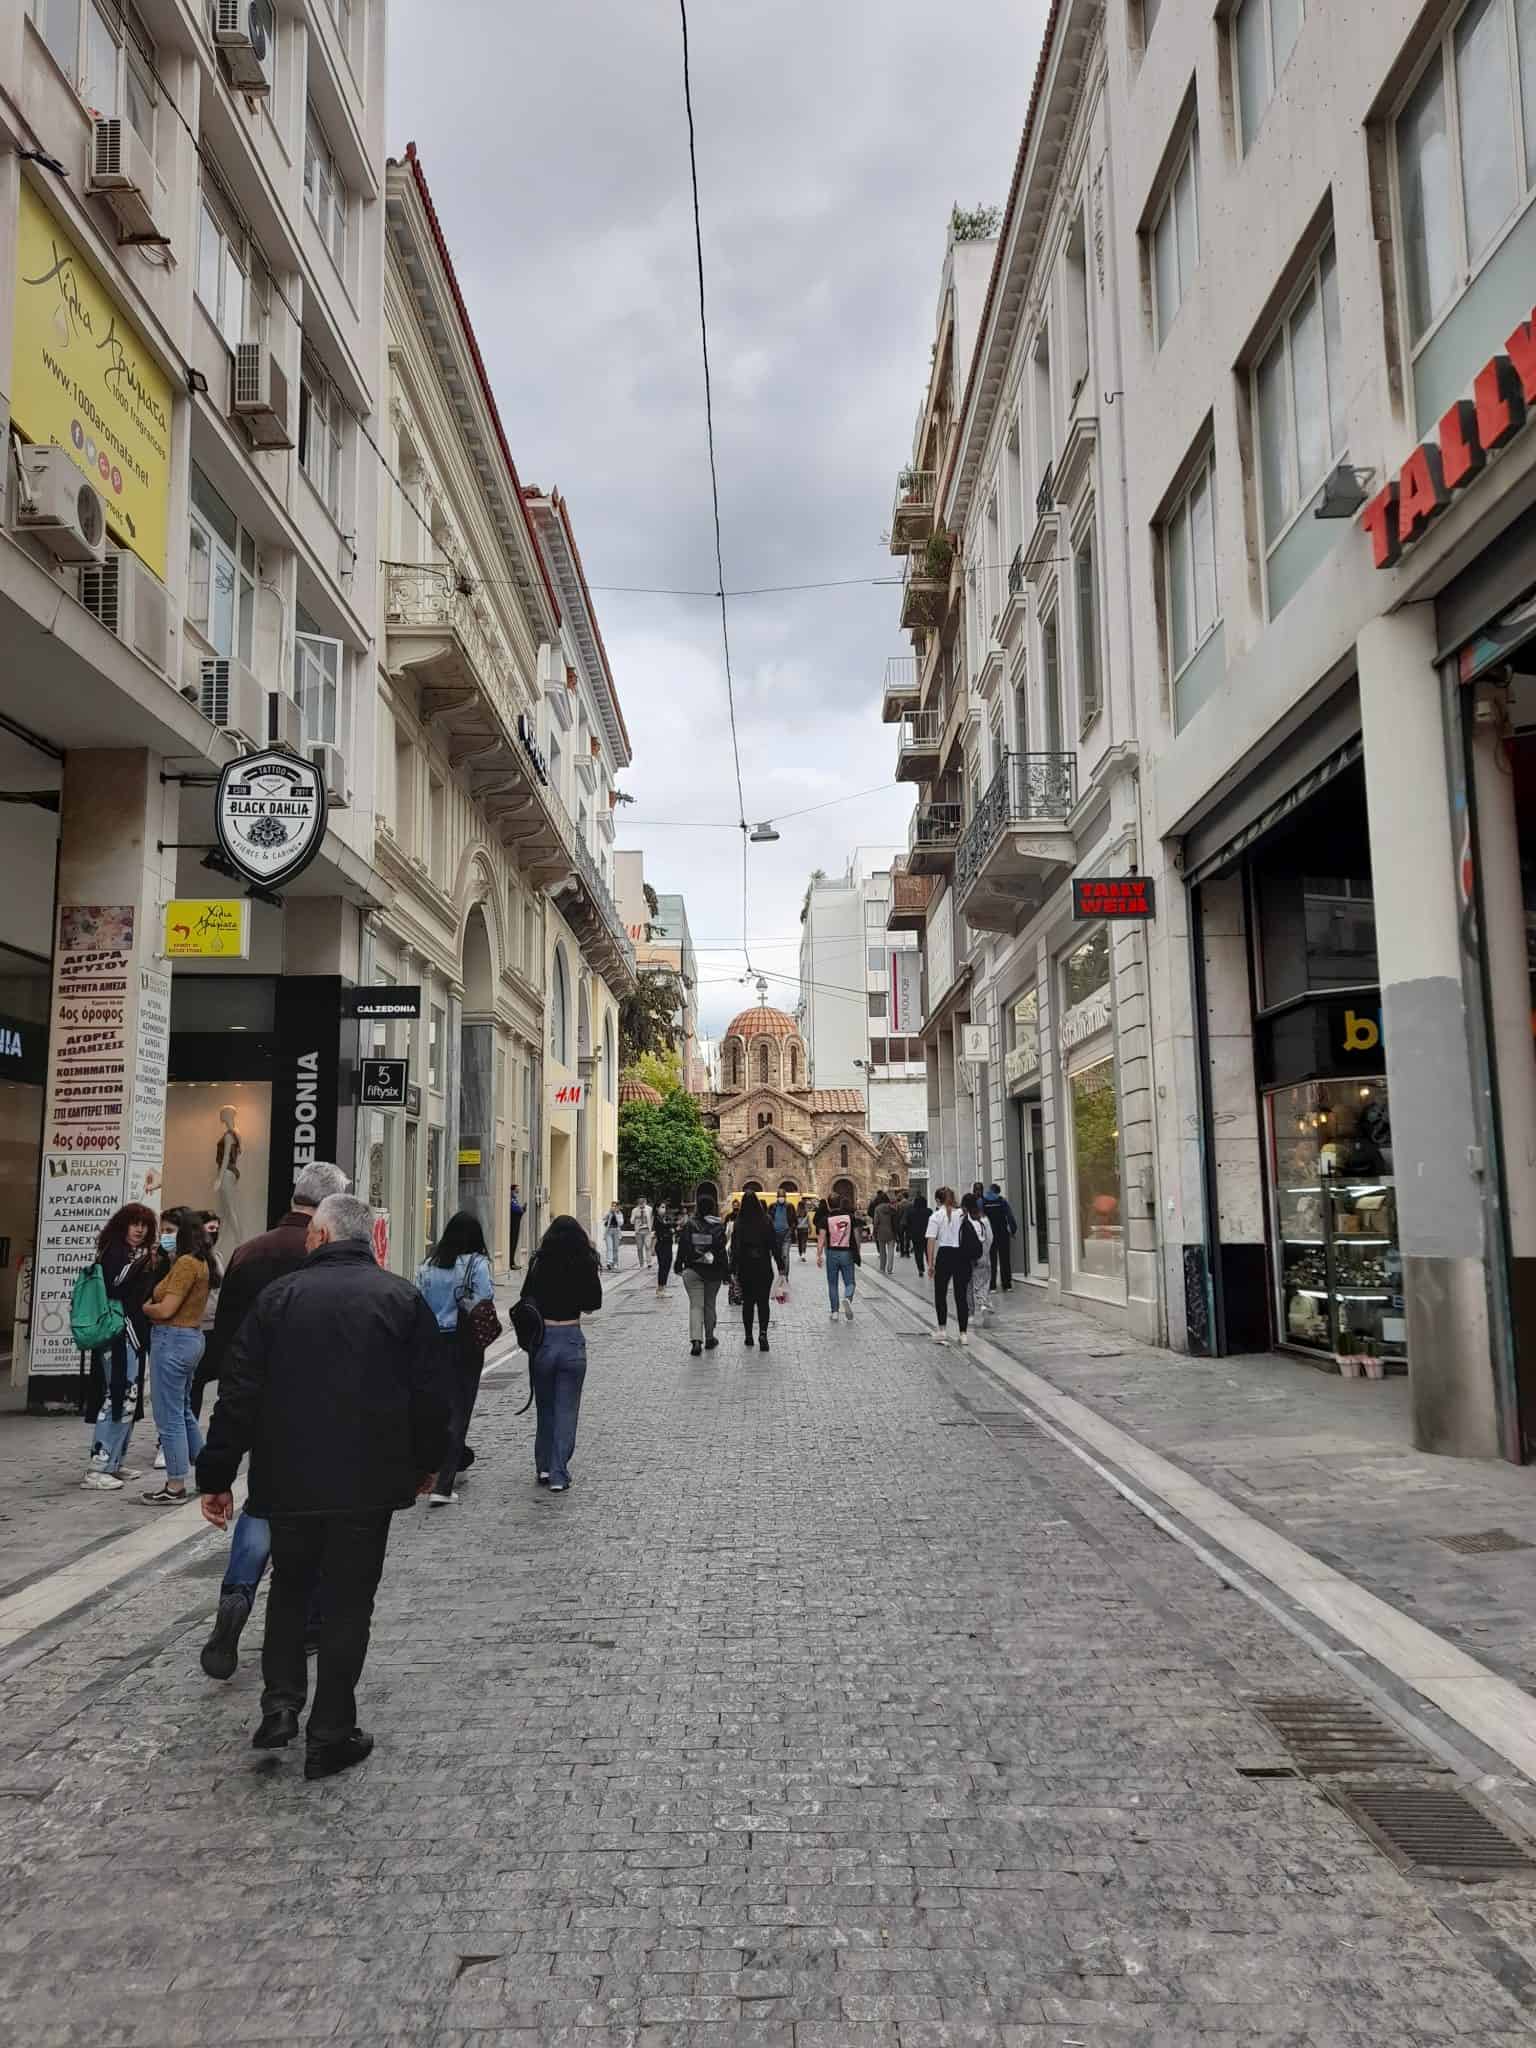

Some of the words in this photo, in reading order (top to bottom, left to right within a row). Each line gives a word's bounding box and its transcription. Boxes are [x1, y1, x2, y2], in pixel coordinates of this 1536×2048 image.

[42, 348, 149, 488] www.1000aromata.net
[257, 765, 287, 776] TATTOO
[230, 801, 265, 814] BLACK
[269, 803, 309, 815] DAHLIA
[64, 951, 122, 965] ΑΓΟΡΑ
[60, 960, 128, 975] ΧΡΥΣΟΥ
[357, 1005, 416, 1013] CALZEDONIA
[367, 1085, 399, 1099] fiftysix
[70, 1168, 121, 1176] MARKET
[66, 1184, 101, 1192] ΑΓΟΡΑ
[49, 1196, 118, 1204] ΧΡΥΣΑΦΙΚΩΝ
[54, 1208, 110, 1216] ΑΣΗΜΙΚΩΝ
[61, 1224, 100, 1232] ΔΑΝΕΙΑ
[47, 1236, 62, 1245] ΜΕ
[65, 1236, 97, 1245] ΕΝΕΧΥ
[57, 1253, 95, 1262] ΠΩΛΗΣ
